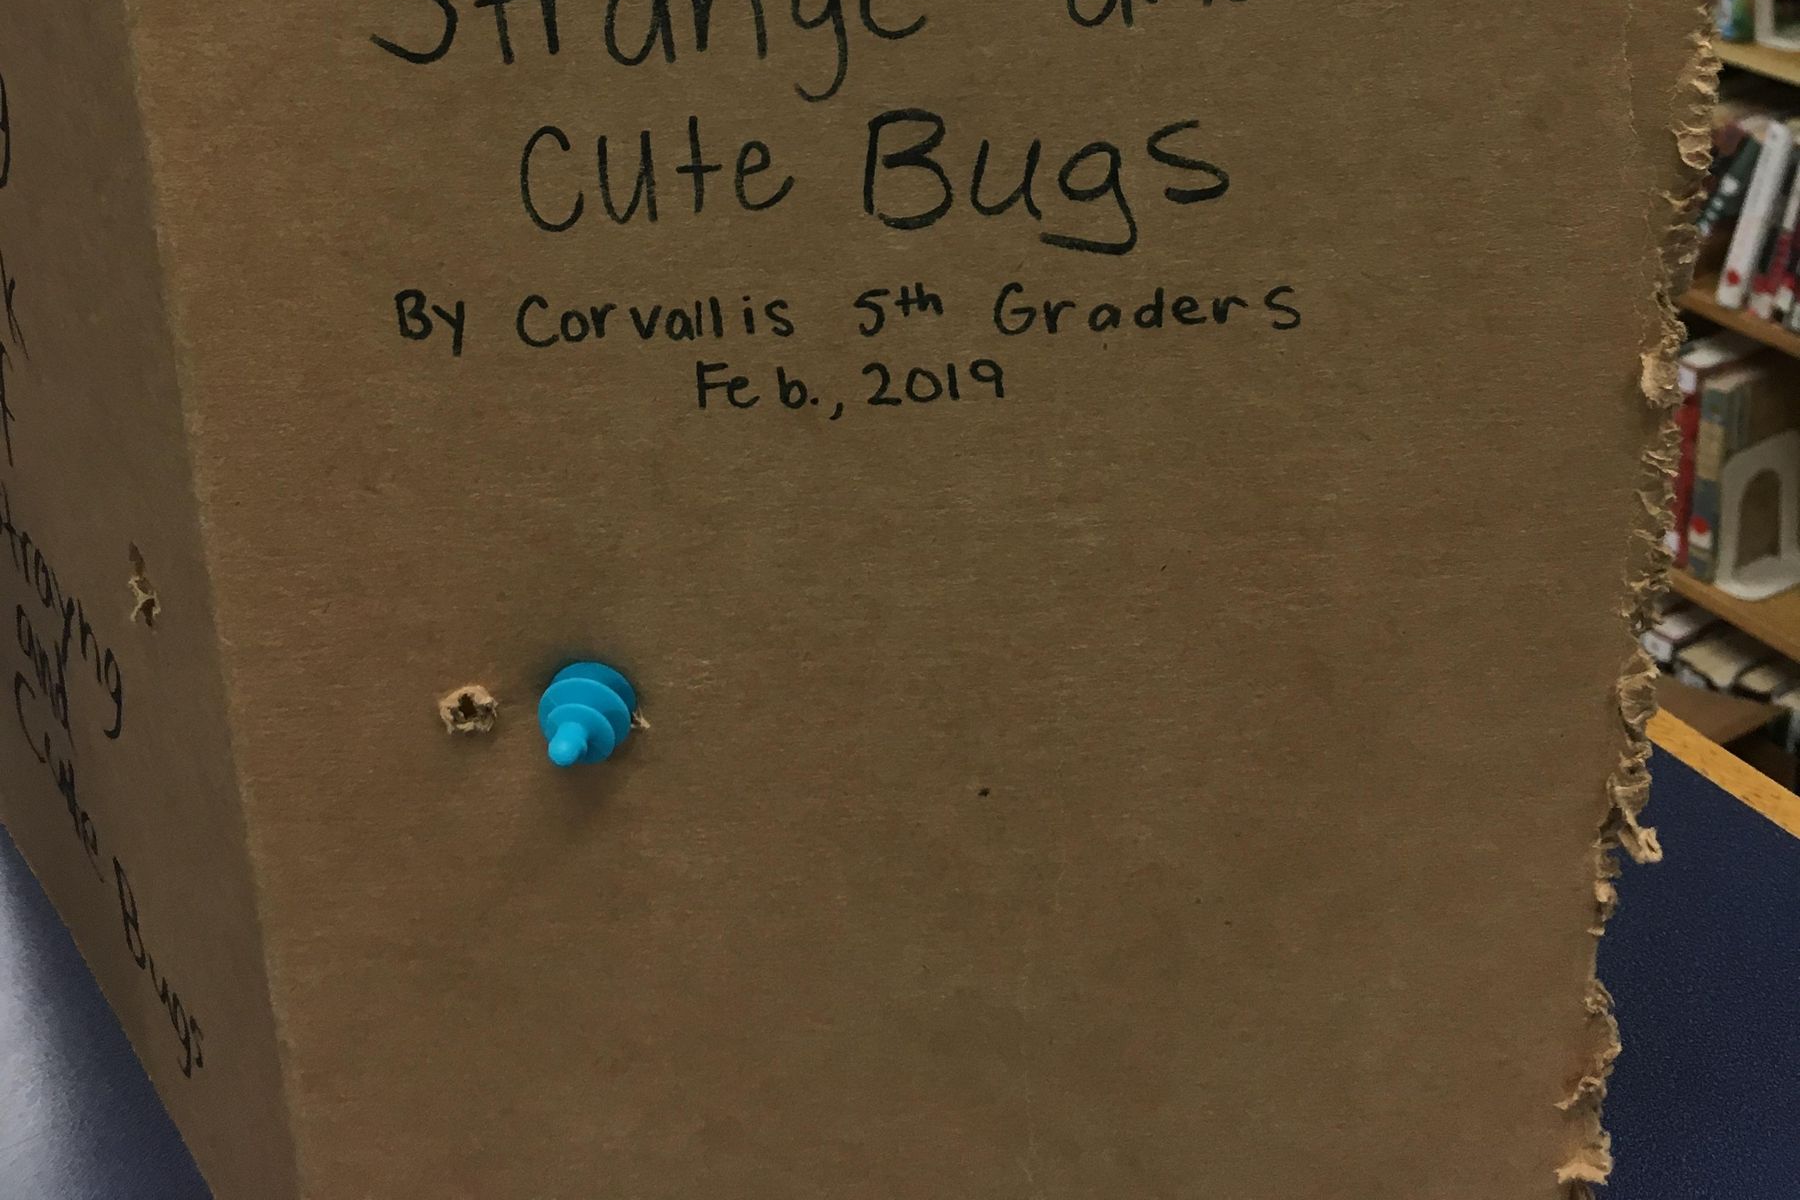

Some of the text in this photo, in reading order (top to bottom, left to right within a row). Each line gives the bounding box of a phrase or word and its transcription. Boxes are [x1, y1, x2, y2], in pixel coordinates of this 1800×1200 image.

[520, 108, 1230, 256] Cute Bugs
[393, 281, 1301, 357] By Corvallis 5th Graders
[695, 358, 1005, 421] Feb., 2019
